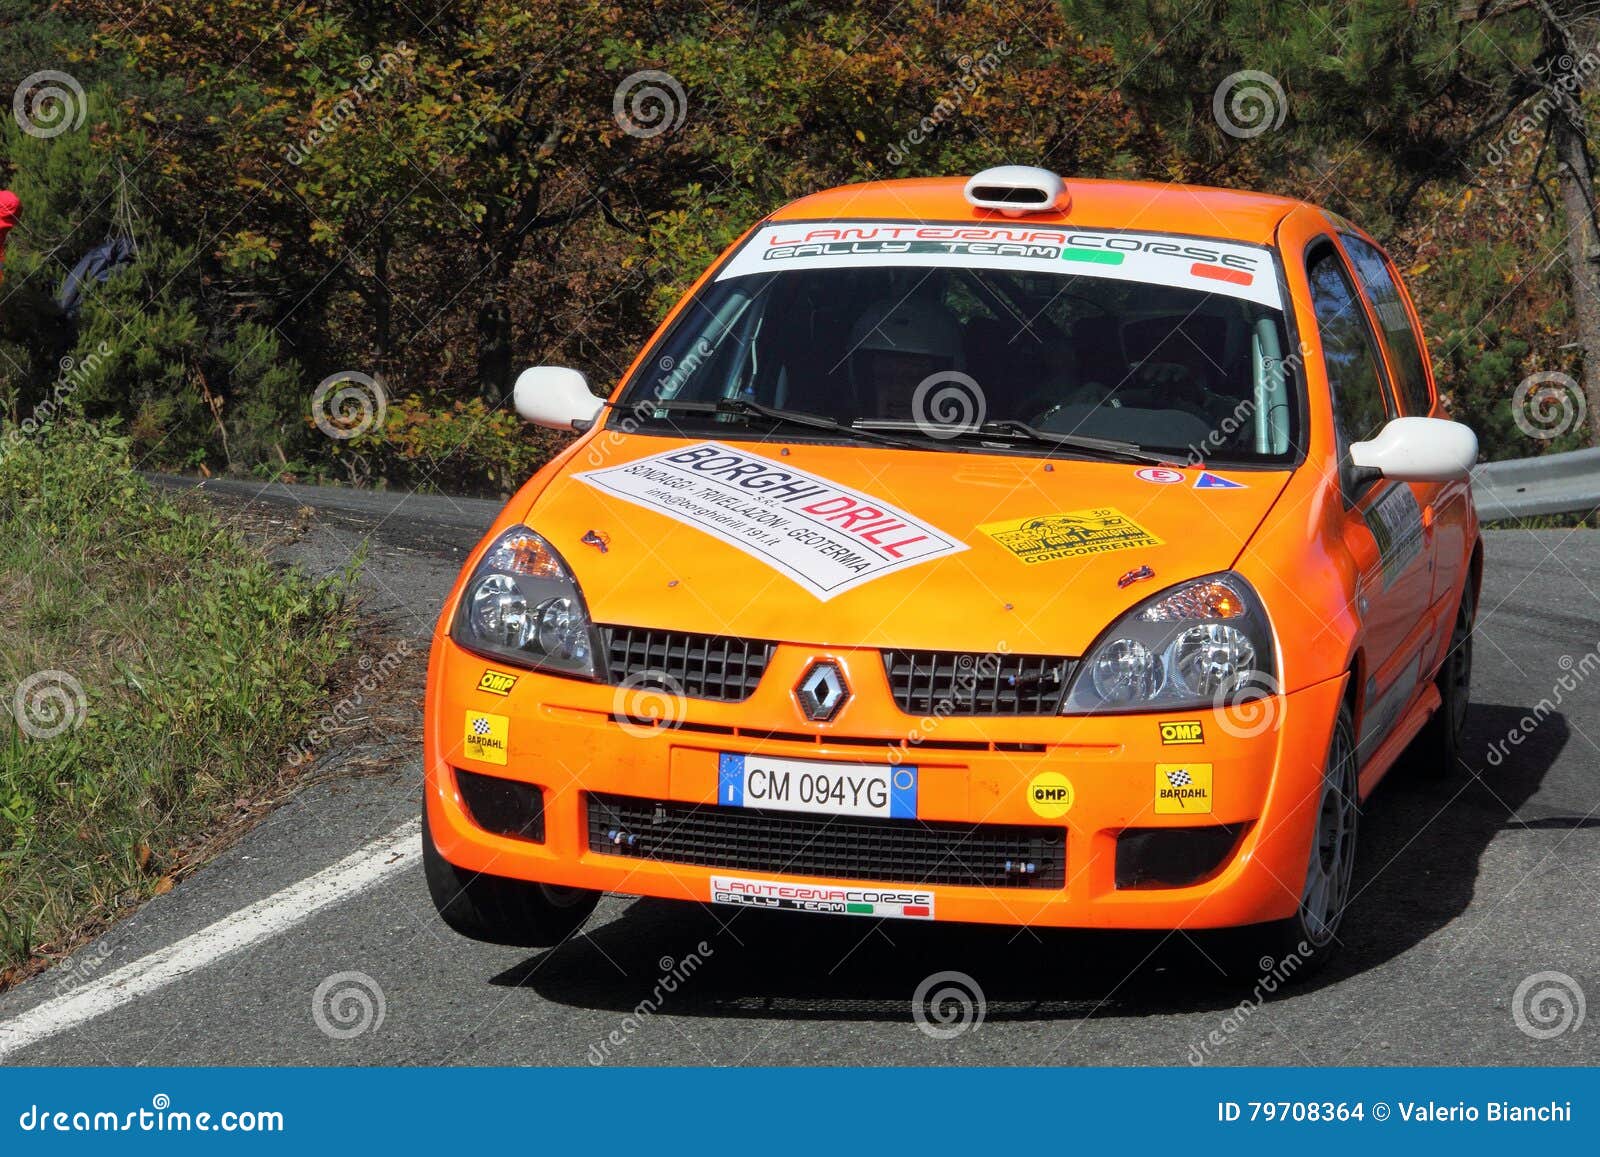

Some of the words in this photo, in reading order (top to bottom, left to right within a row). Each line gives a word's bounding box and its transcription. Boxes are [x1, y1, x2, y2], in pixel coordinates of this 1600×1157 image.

[764, 242, 912, 260] RALLY
[941, 242, 1059, 259] TEAM
[1152, 470, 1171, 478] E
[664, 448, 829, 503] BORGHI
[801, 496, 929, 559] DRILL
[624, 465, 691, 491] SONDAGGI
[787, 528, 872, 573] GEOTERMIA
[1024, 539, 1158, 564] CONCORRENTE
[481, 673, 514, 691] OMP
[1162, 725, 1202, 740] OMP
[467, 734, 504, 750] BARDAHL
[728, 785, 734, 802] I
[747, 769, 790, 802] CM
[799, 773, 888, 808] 094YG
[1034, 788, 1067, 801] OMP
[1160, 787, 1207, 799] BARDAHL
[715, 892, 780, 907] RALLY
[792, 900, 846, 912] TEAM
